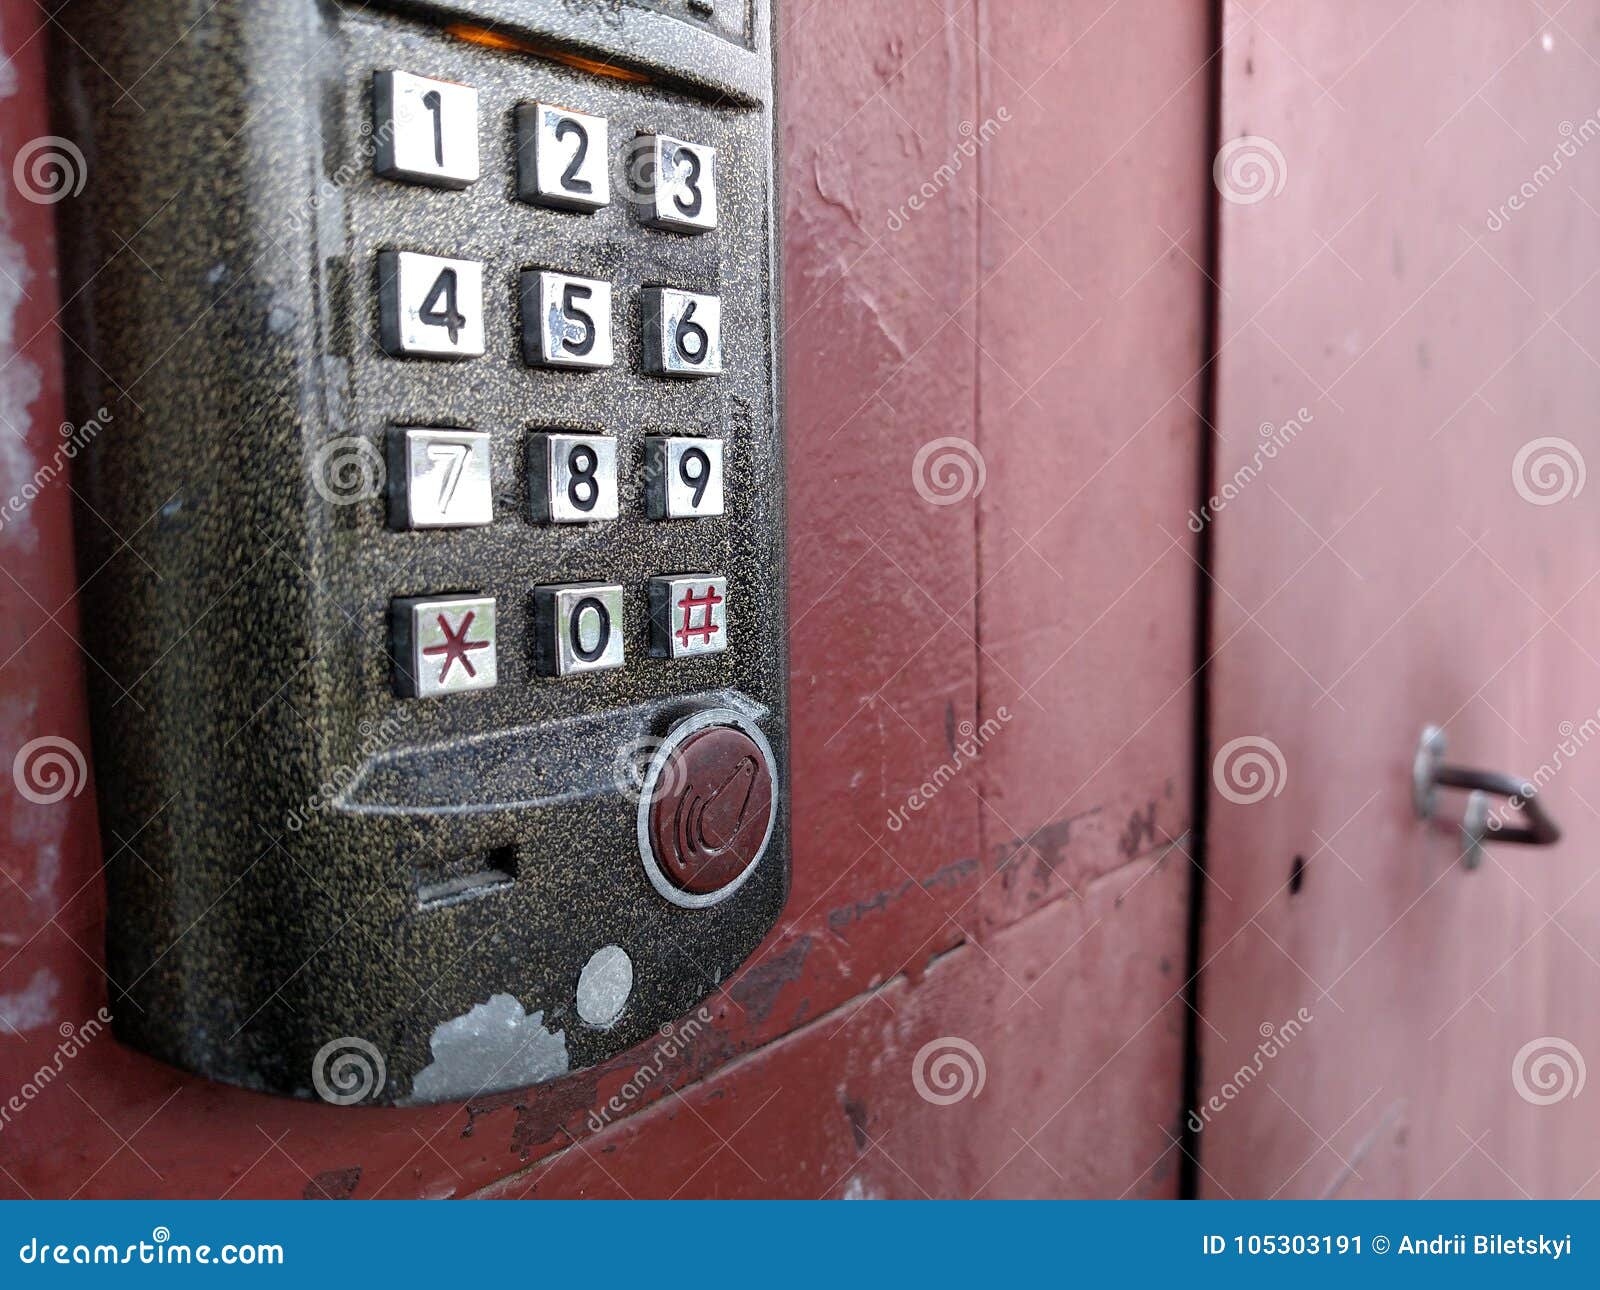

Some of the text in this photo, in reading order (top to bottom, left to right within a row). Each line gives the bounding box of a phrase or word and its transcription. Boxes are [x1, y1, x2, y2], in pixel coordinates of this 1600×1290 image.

[421, 89, 444, 168] 1
[555, 118, 593, 195] 2
[673, 147, 703, 218] 3
[418, 267, 466, 346] 4
[561, 283, 596, 358] 5
[675, 301, 709, 365] 6
[427, 443, 473, 515] 7
[567, 444, 600, 512] 8
[679, 447, 711, 509] 9
[569, 596, 611, 663] 0
